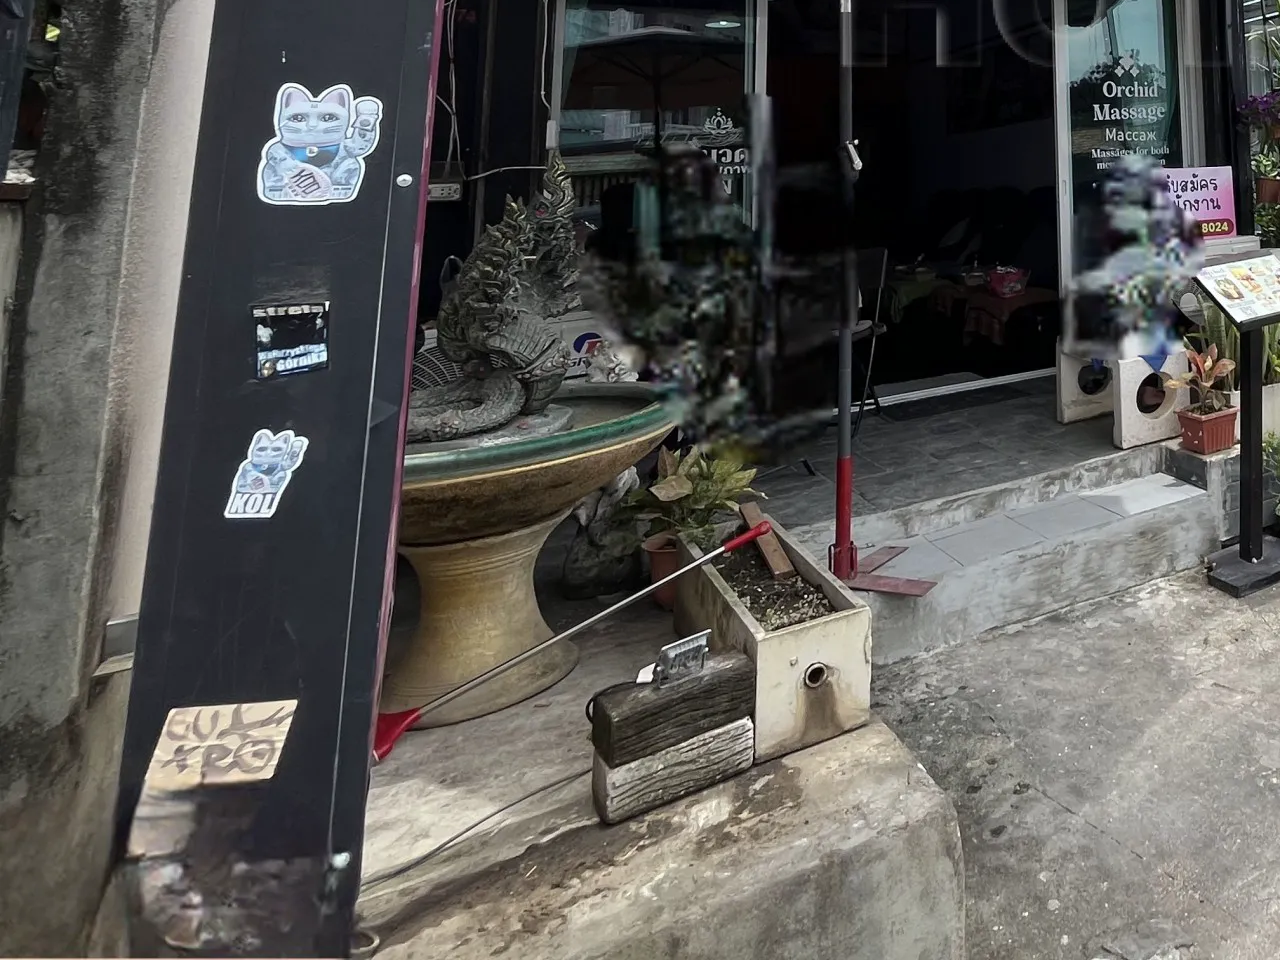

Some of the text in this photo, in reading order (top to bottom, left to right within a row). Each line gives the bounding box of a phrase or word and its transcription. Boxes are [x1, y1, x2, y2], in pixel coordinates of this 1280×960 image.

[1102, 80, 1159, 98] Orchid
[1093, 103, 1166, 123] Massage
[1105, 127, 1157, 141] Массаж
[1136, 146, 1148, 155] for
[1150, 145, 1169, 155] both
[229, 493, 275, 514] KOL
